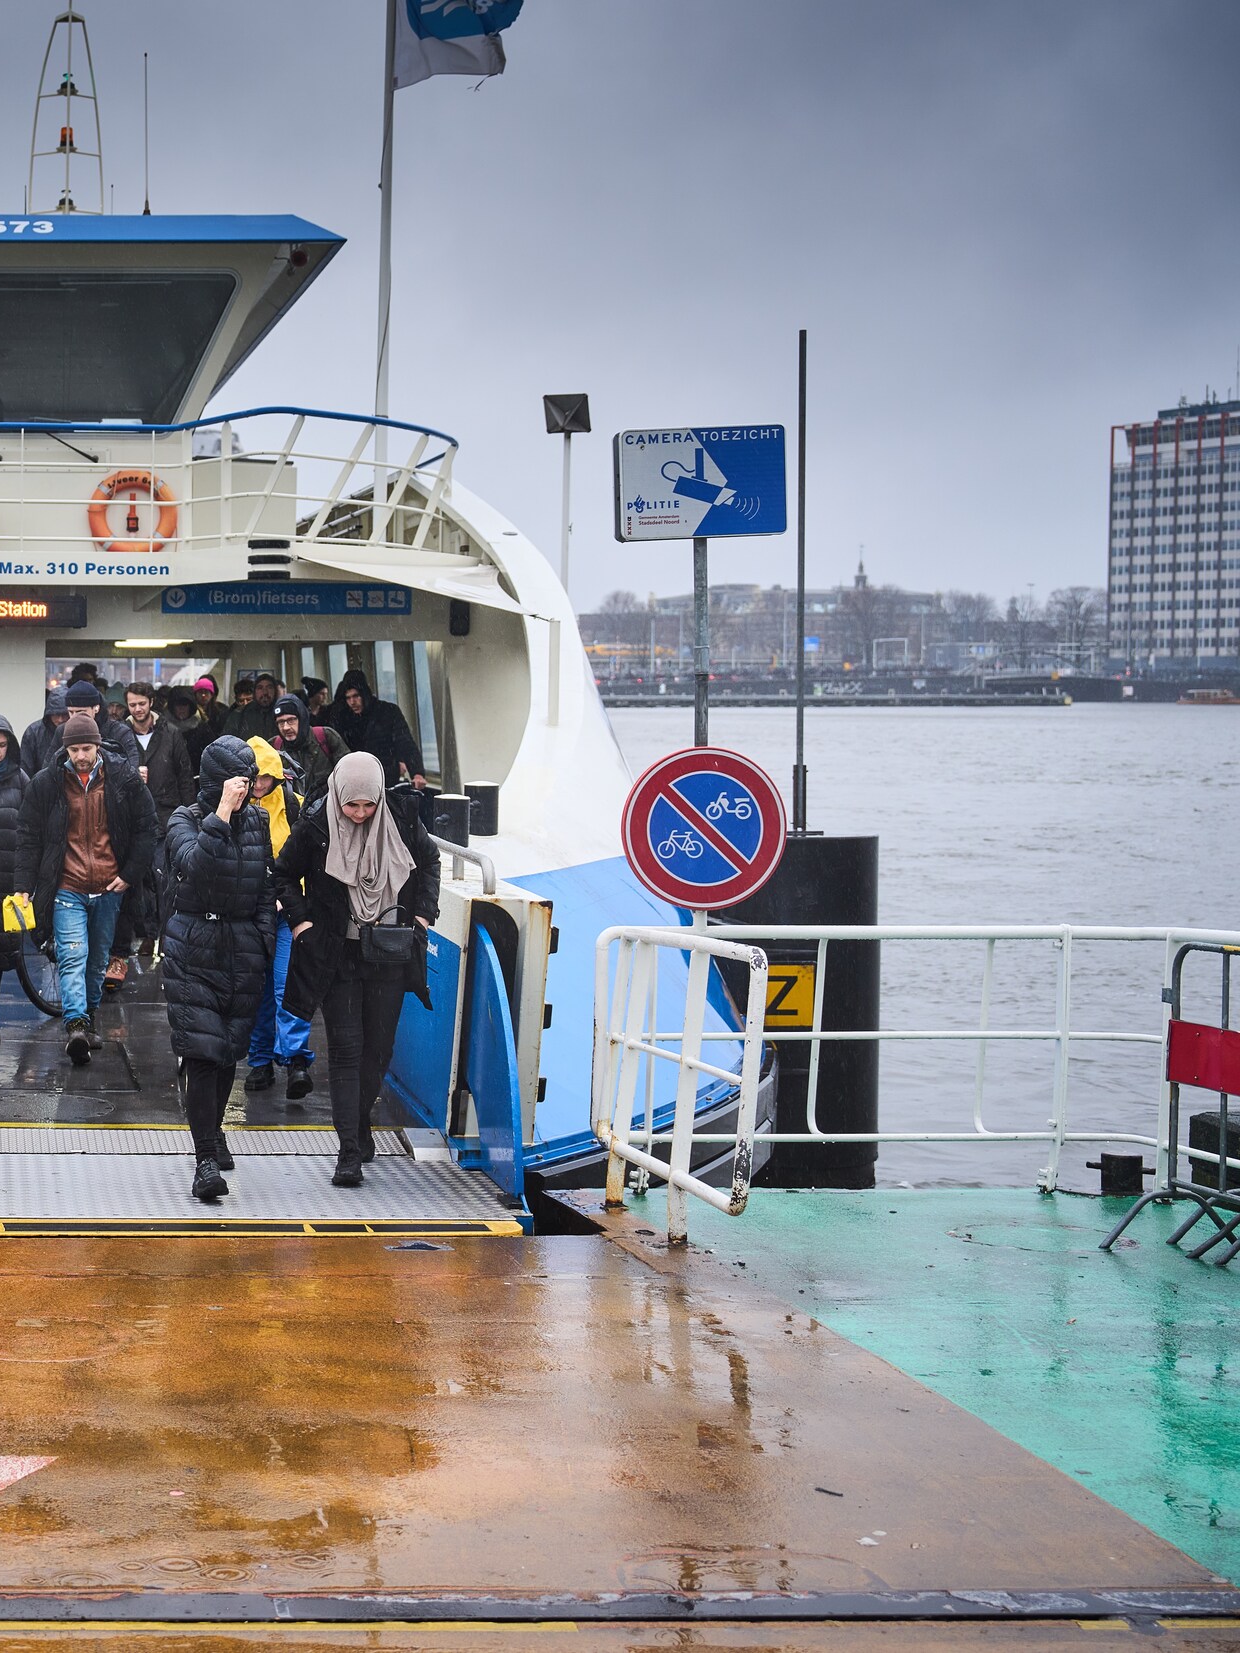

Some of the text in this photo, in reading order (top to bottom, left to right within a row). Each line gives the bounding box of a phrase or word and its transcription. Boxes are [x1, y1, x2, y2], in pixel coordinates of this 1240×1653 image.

[624, 428, 780, 446] CAMERA TOEZICHT
[46, 562, 79, 575] 310
[85, 562, 170, 576] Personen
[208, 590, 320, 606] (Brom)fietsers
[765, 975, 799, 1016] Z
